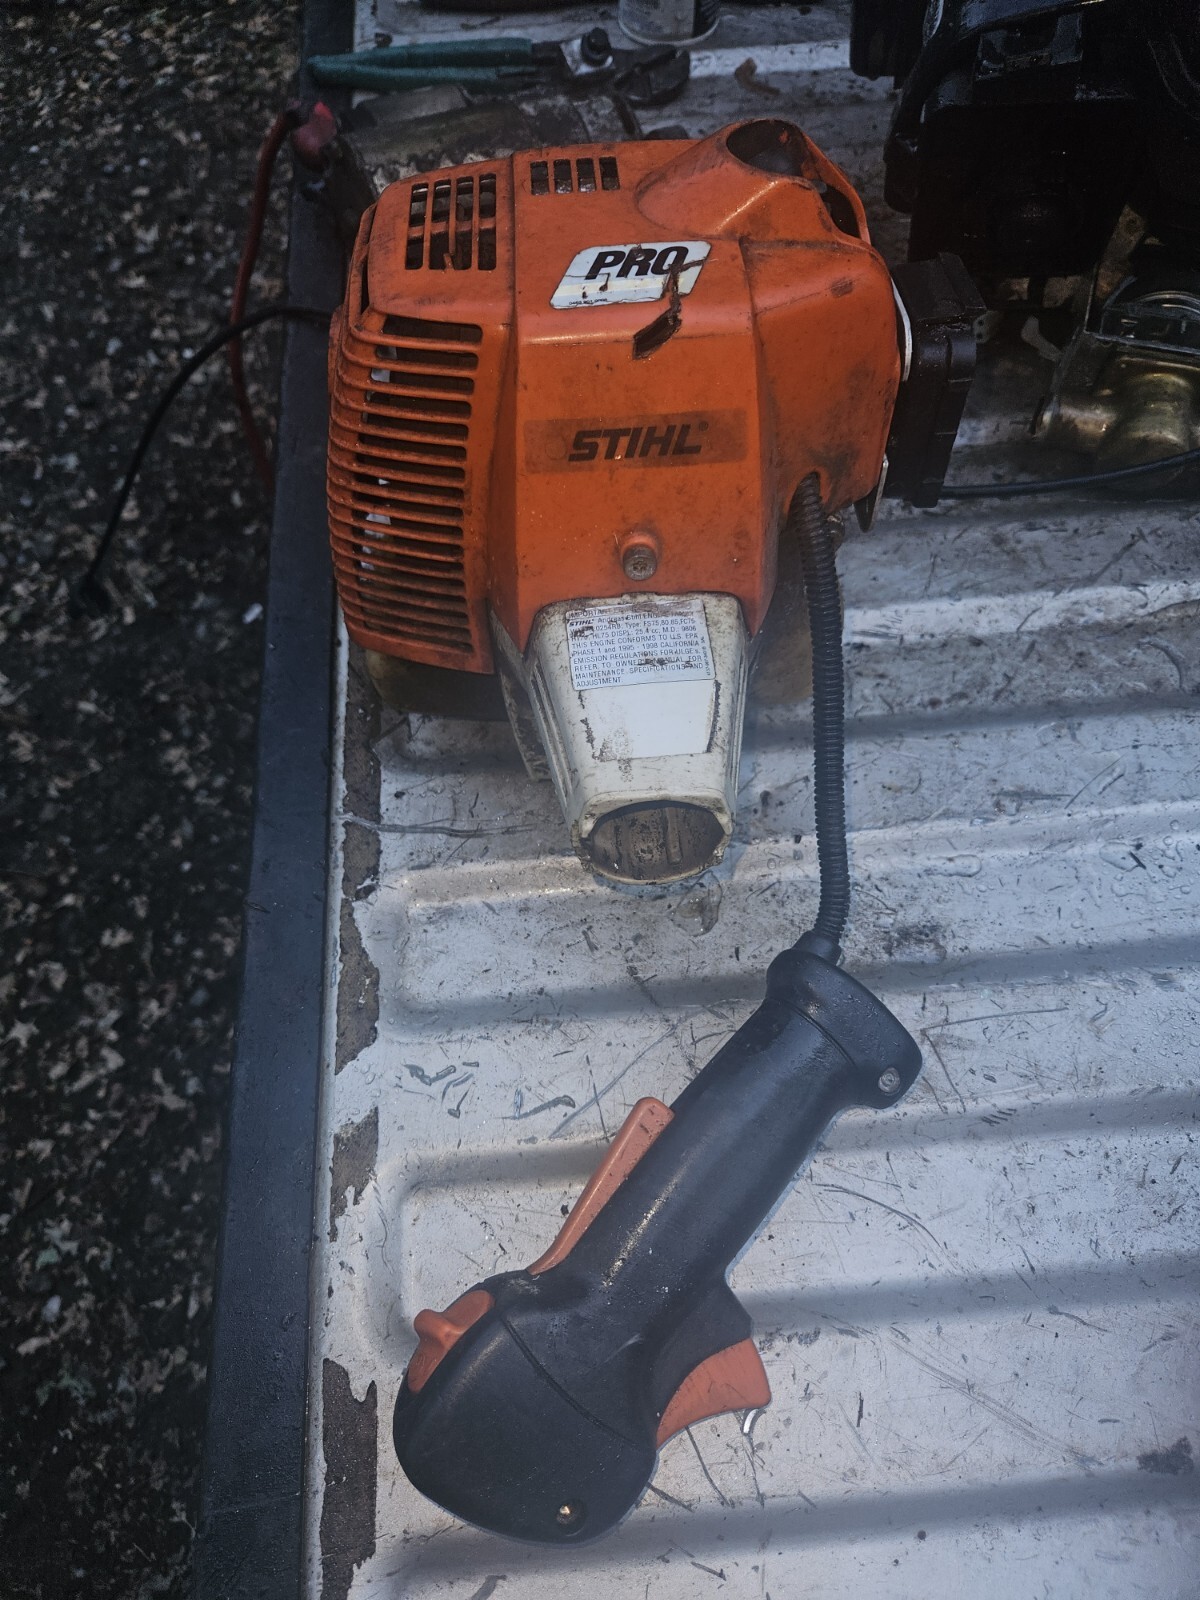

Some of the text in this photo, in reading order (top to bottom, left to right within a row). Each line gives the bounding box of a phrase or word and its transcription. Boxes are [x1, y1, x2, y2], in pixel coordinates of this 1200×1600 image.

[584, 246, 689, 280] PRO
[569, 609, 608, 618] IMPORTA
[597, 616, 625, 624] Andreas
[635, 627, 649, 635] 25.4
[572, 641, 588, 649] THIS
[590, 638, 616, 647] ENGINE
[617, 634, 657, 644] CONFORMS
[573, 648, 596, 656] PHASE
[660, 639, 700, 648] CALIFORNIA
[573, 654, 608, 665] EMISSION
[609, 649, 658, 660] REGULATIONS
[574, 663, 598, 672] REFER
[602, 661, 612, 669] TO
